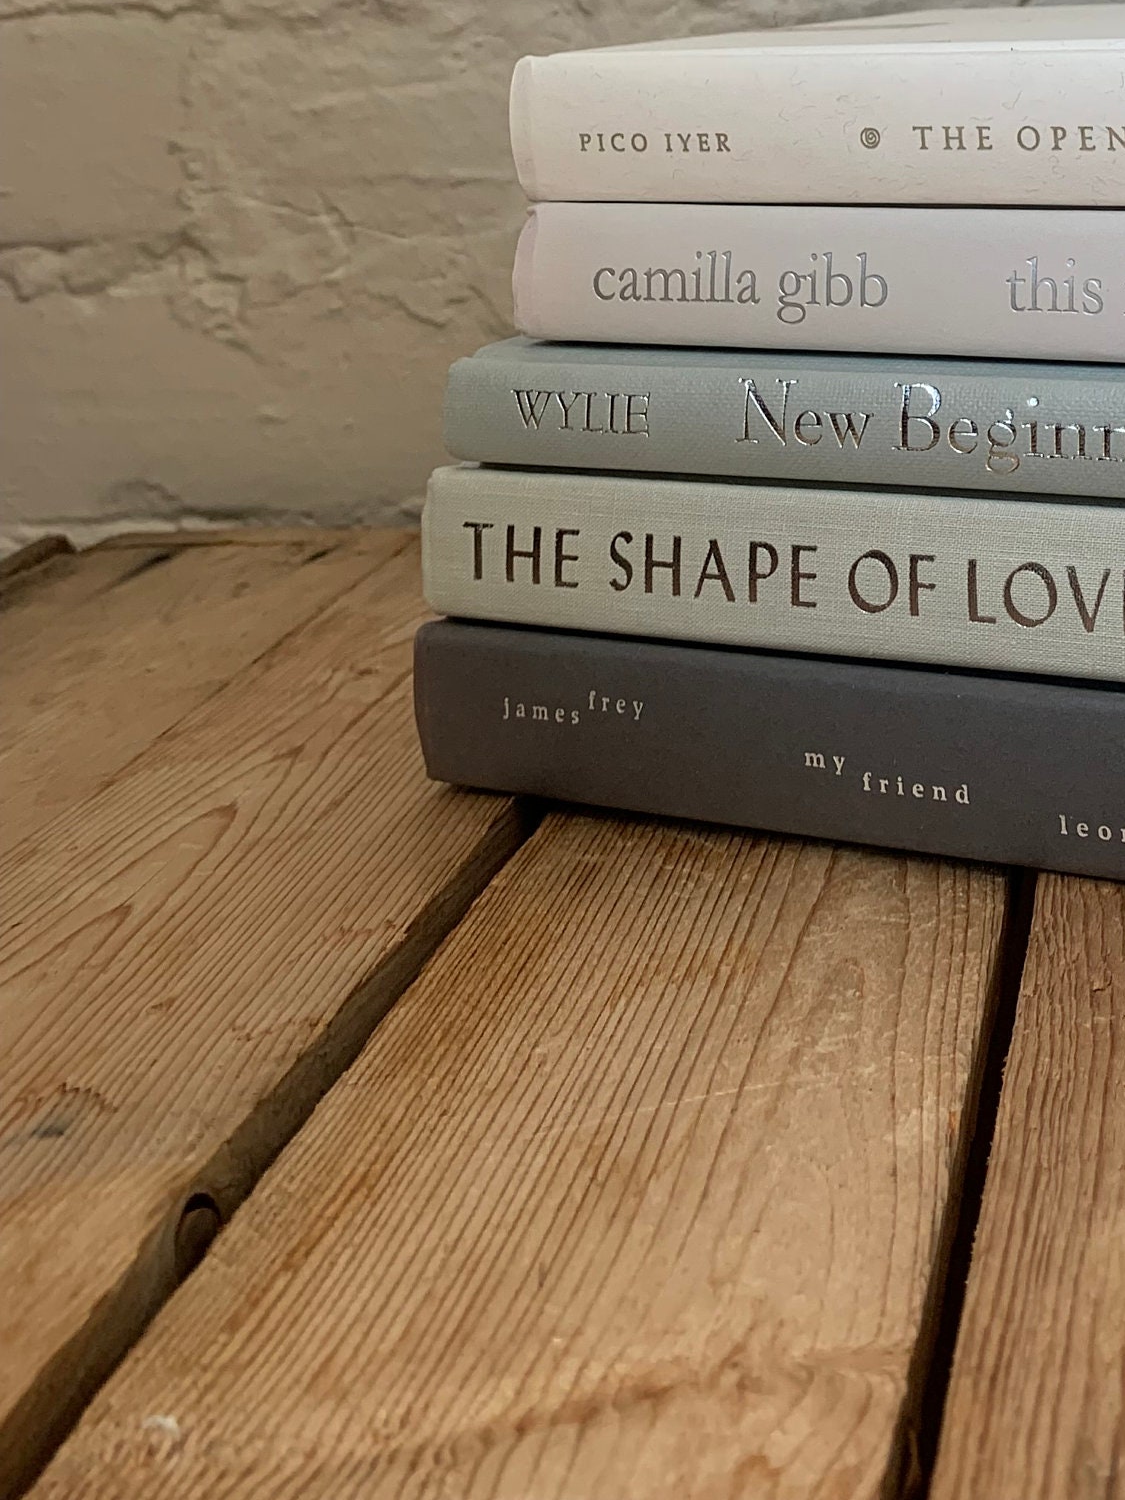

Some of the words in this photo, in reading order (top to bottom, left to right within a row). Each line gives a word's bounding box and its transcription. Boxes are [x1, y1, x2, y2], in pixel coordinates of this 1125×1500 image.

[579, 131, 649, 154] PICO
[664, 133, 733, 153] IYER
[913, 125, 994, 151] THE
[593, 250, 761, 305] camilla
[777, 251, 889, 324] gibb
[1005, 256, 1106, 316] this
[511, 387, 651, 437] WYLIE
[735, 377, 873, 449] New
[462, 521, 580, 589] THE
[607, 530, 818, 608] SHAPE
[847, 548, 937, 616] OF
[502, 697, 580, 725] james
[588, 690, 645, 720] frey
[804, 750, 845, 776] my
[861, 771, 971, 804] friend
